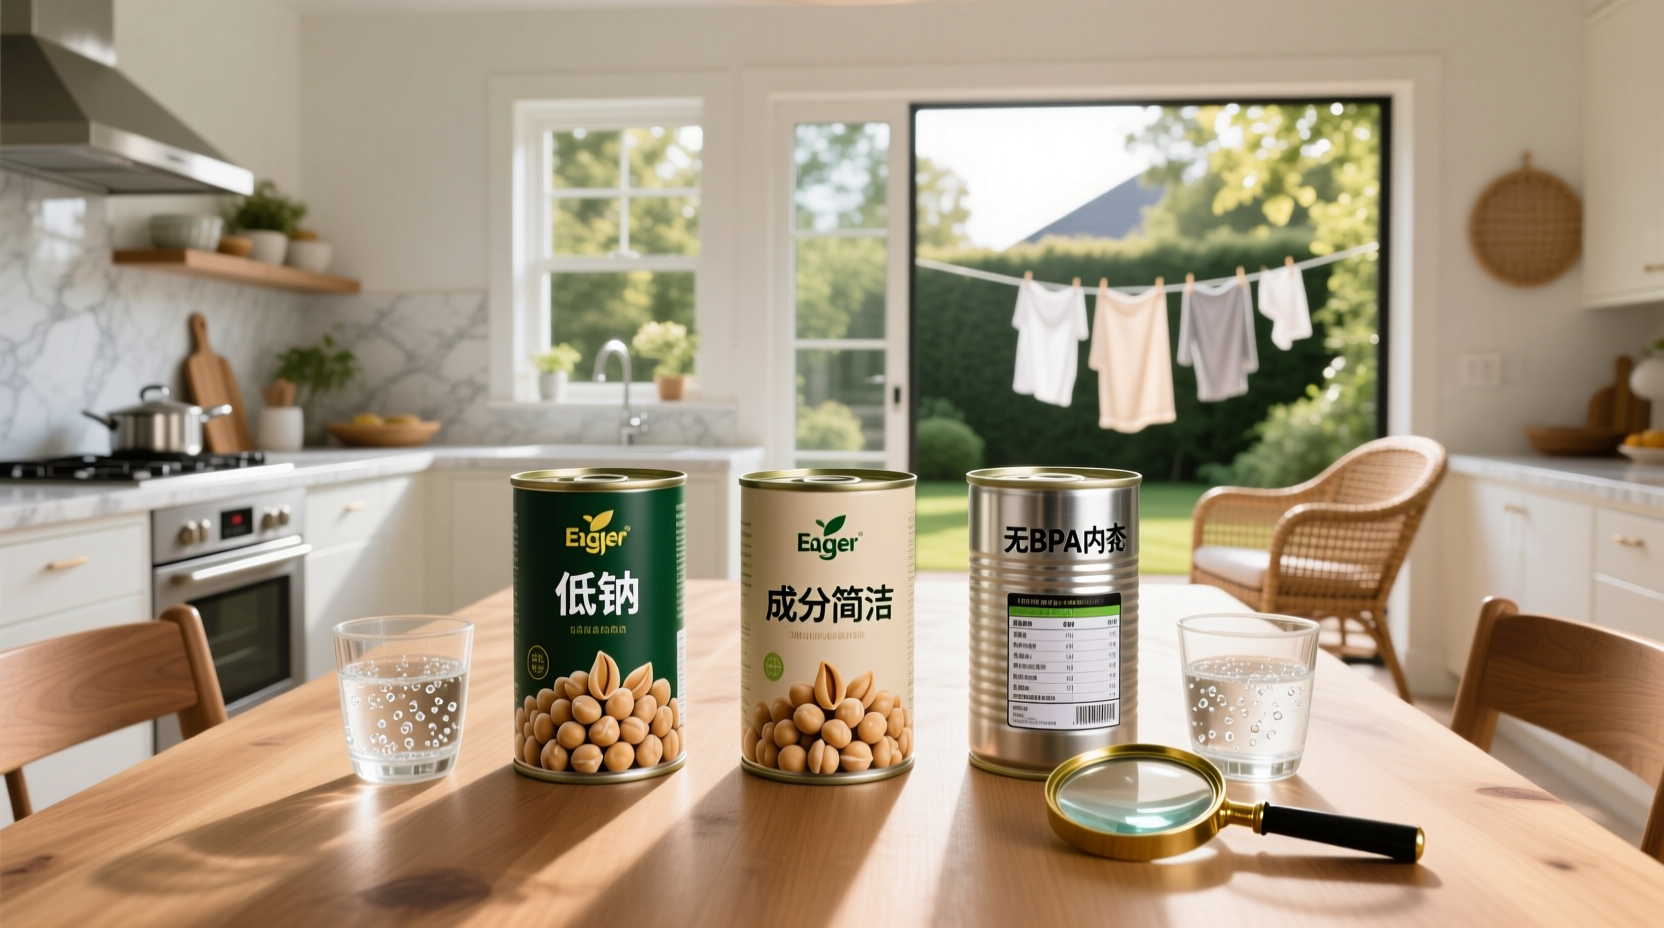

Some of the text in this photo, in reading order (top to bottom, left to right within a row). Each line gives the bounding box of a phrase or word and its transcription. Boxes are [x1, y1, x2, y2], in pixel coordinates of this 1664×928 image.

[555, 570, 639, 616] 低钠
[766, 584, 894, 624] 成分简洁
